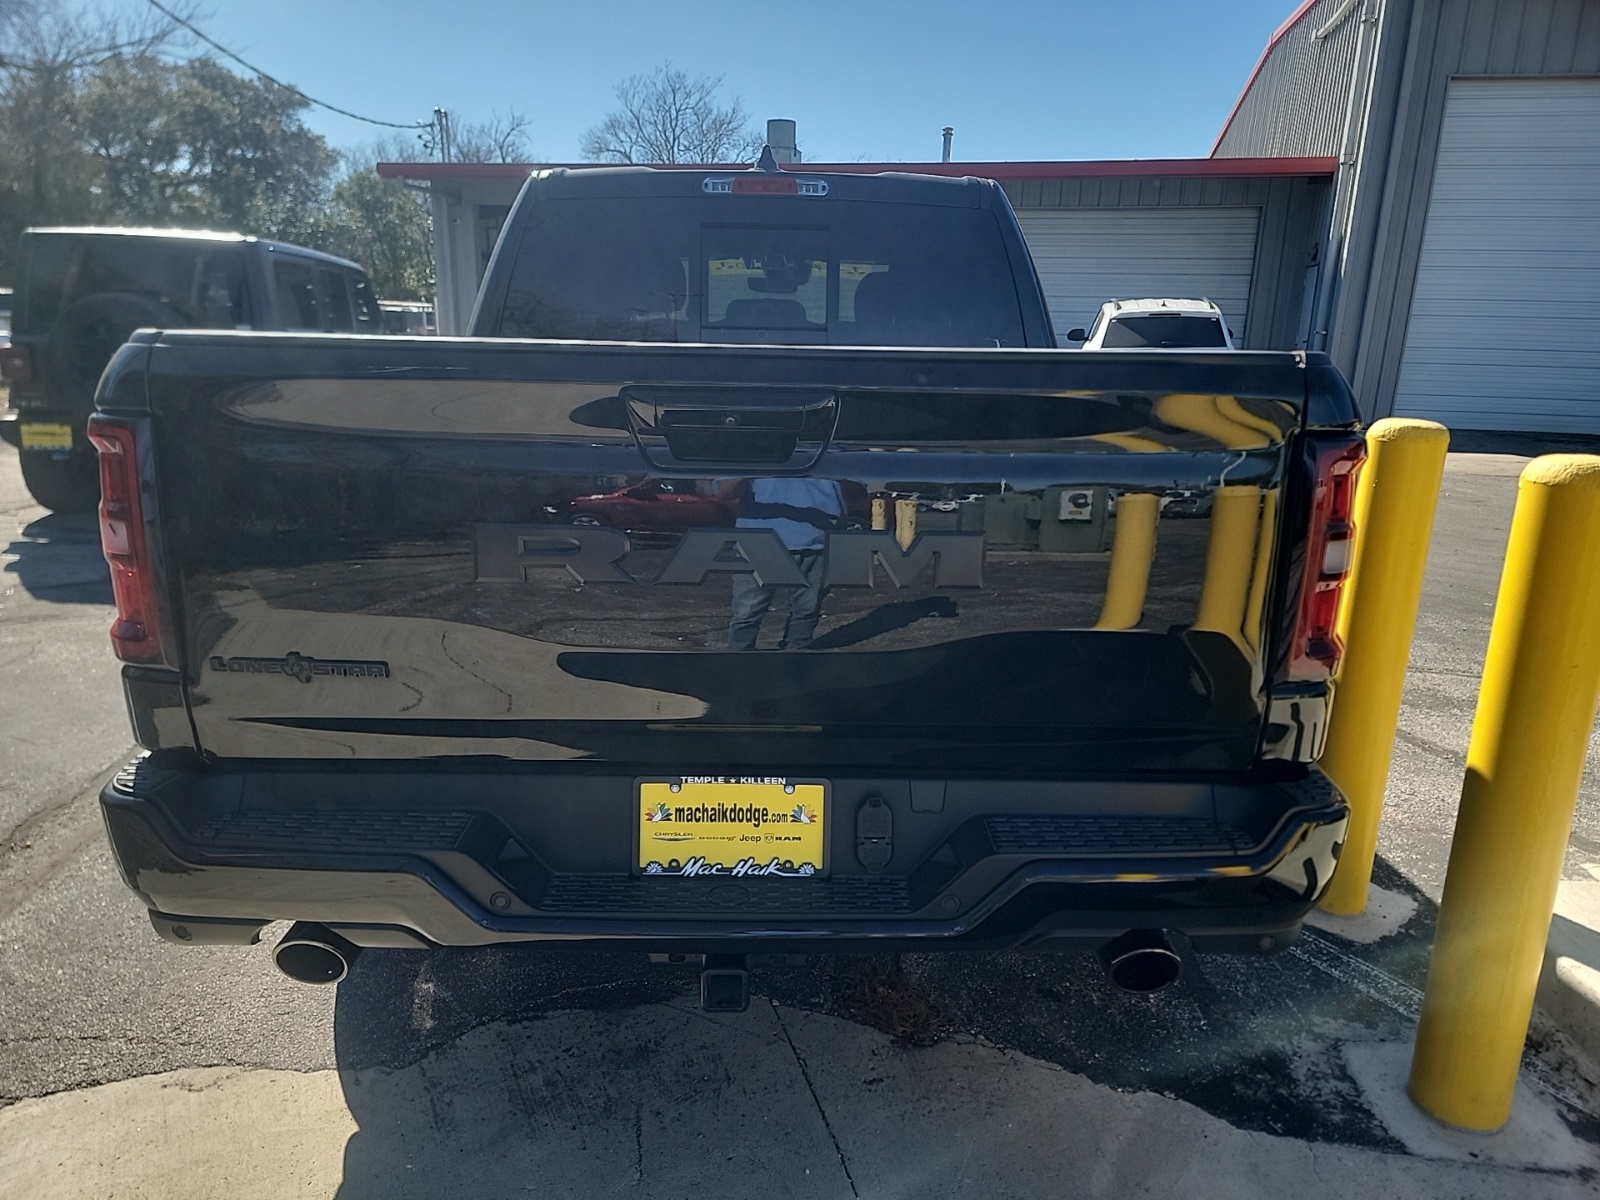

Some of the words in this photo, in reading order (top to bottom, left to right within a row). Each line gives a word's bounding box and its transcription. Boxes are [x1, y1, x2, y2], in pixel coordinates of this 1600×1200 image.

[473, 523, 986, 588] RAM
[209, 656, 284, 674] LONE
[312, 659, 390, 678] STAR
[680, 776, 726, 785] TEMPLE
[740, 776, 787, 785] KILLEEN
[674, 802, 789, 829] machaikdodge.com
[739, 833, 762, 843] Jeep
[680, 857, 728, 877] Mac
[730, 858, 784, 877] Haik
